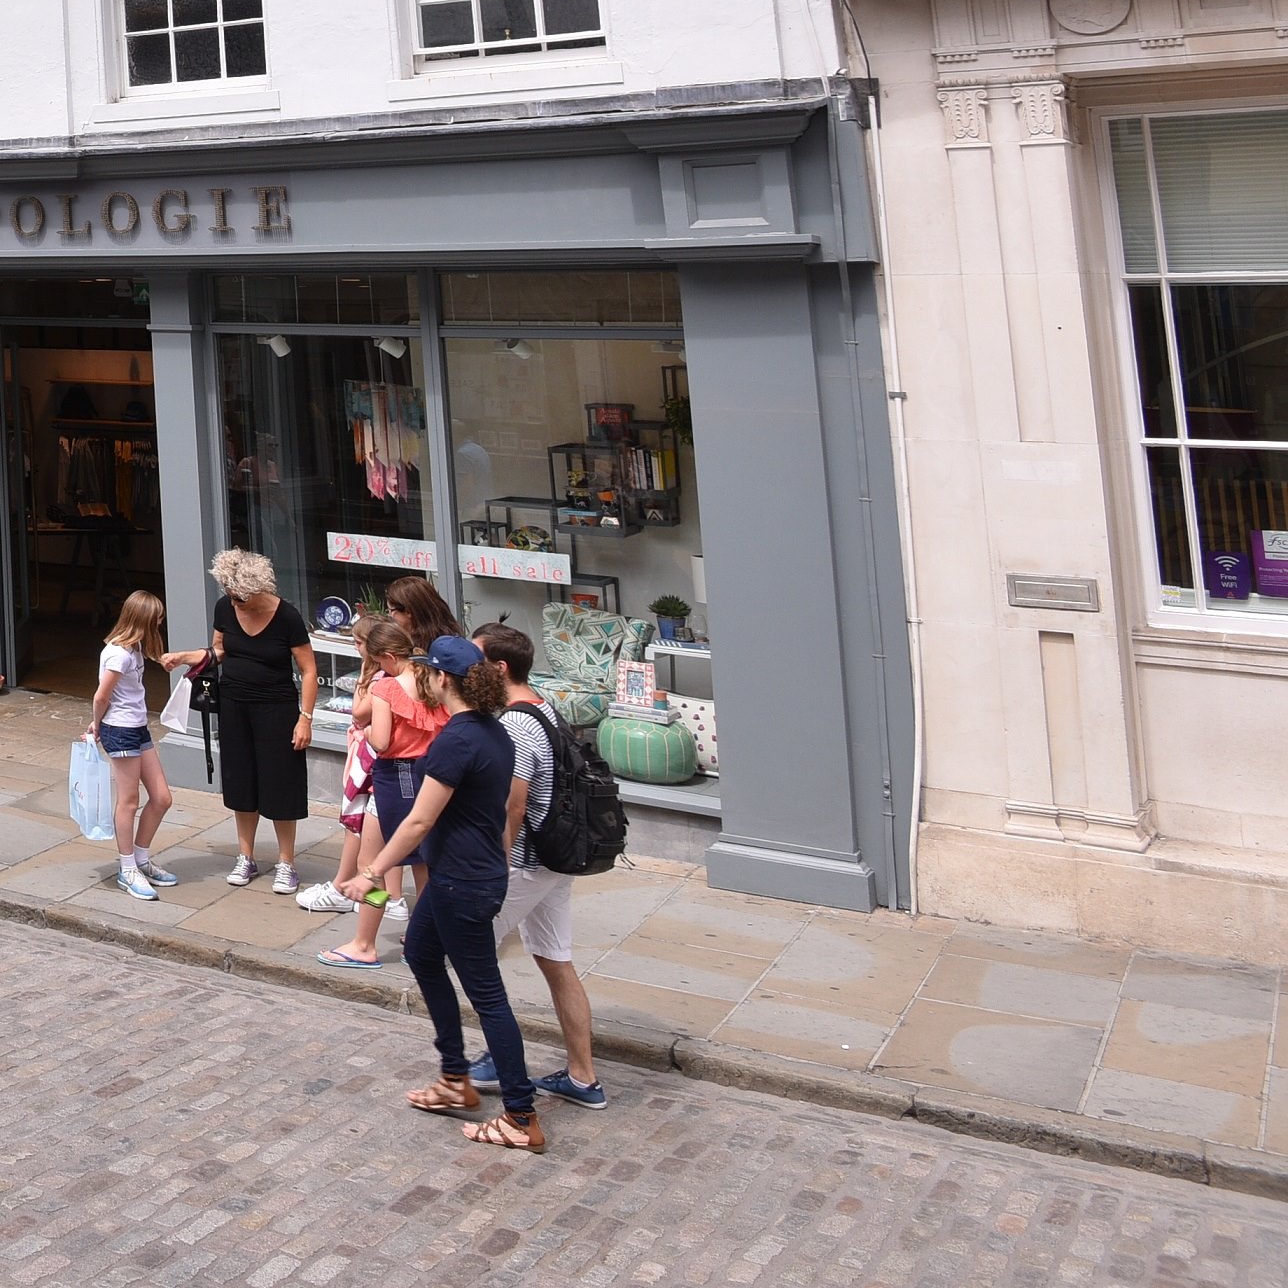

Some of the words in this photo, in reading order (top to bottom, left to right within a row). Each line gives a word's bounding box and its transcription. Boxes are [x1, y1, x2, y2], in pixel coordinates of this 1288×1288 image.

[334, 536, 390, 562] 20%
[401, 551, 433, 569] off
[466, 556, 499, 575] all
[512, 563, 564, 581] sale
[1220, 573, 1237, 581] Free
